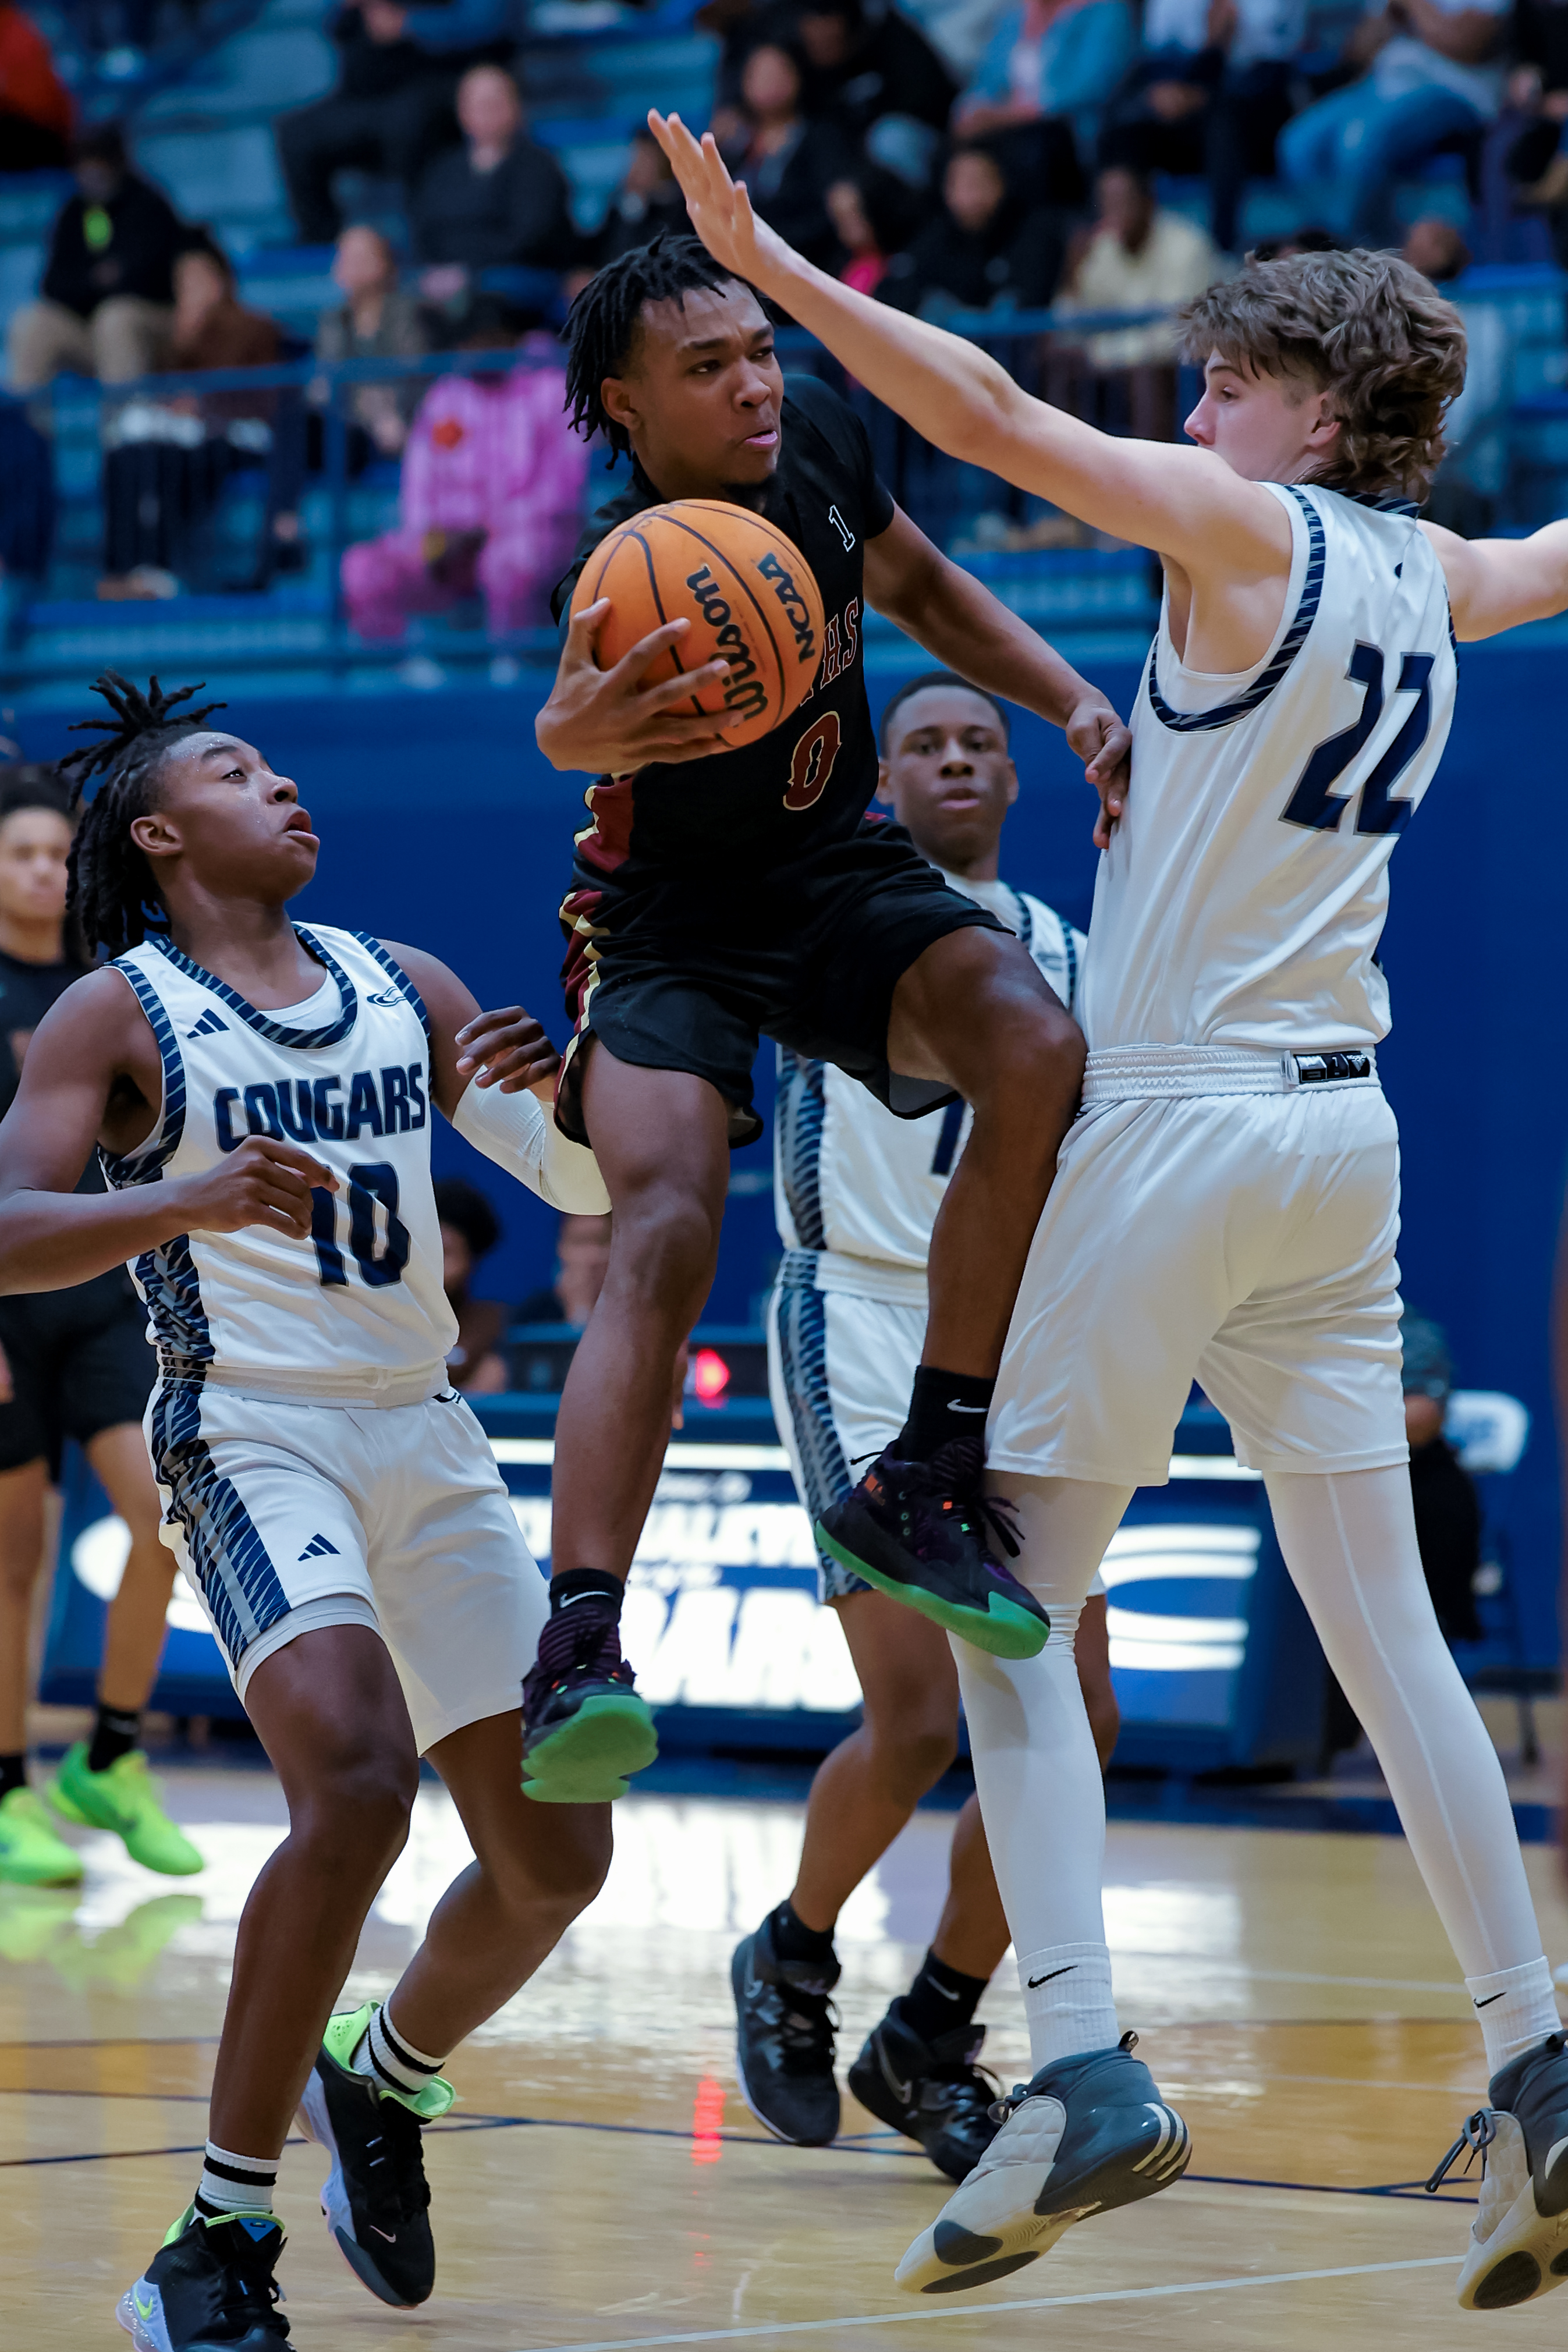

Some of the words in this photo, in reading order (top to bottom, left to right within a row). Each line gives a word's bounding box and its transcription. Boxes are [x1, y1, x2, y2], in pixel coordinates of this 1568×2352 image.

[686, 563, 768, 728] Wilson
[757, 552, 815, 664] NCAA
[800, 596, 859, 707] HS
[783, 711, 842, 810] 0
[1278, 638, 1435, 836] 22
[213, 1062, 426, 1154] COUGARS
[309, 1161, 411, 1289] 10
